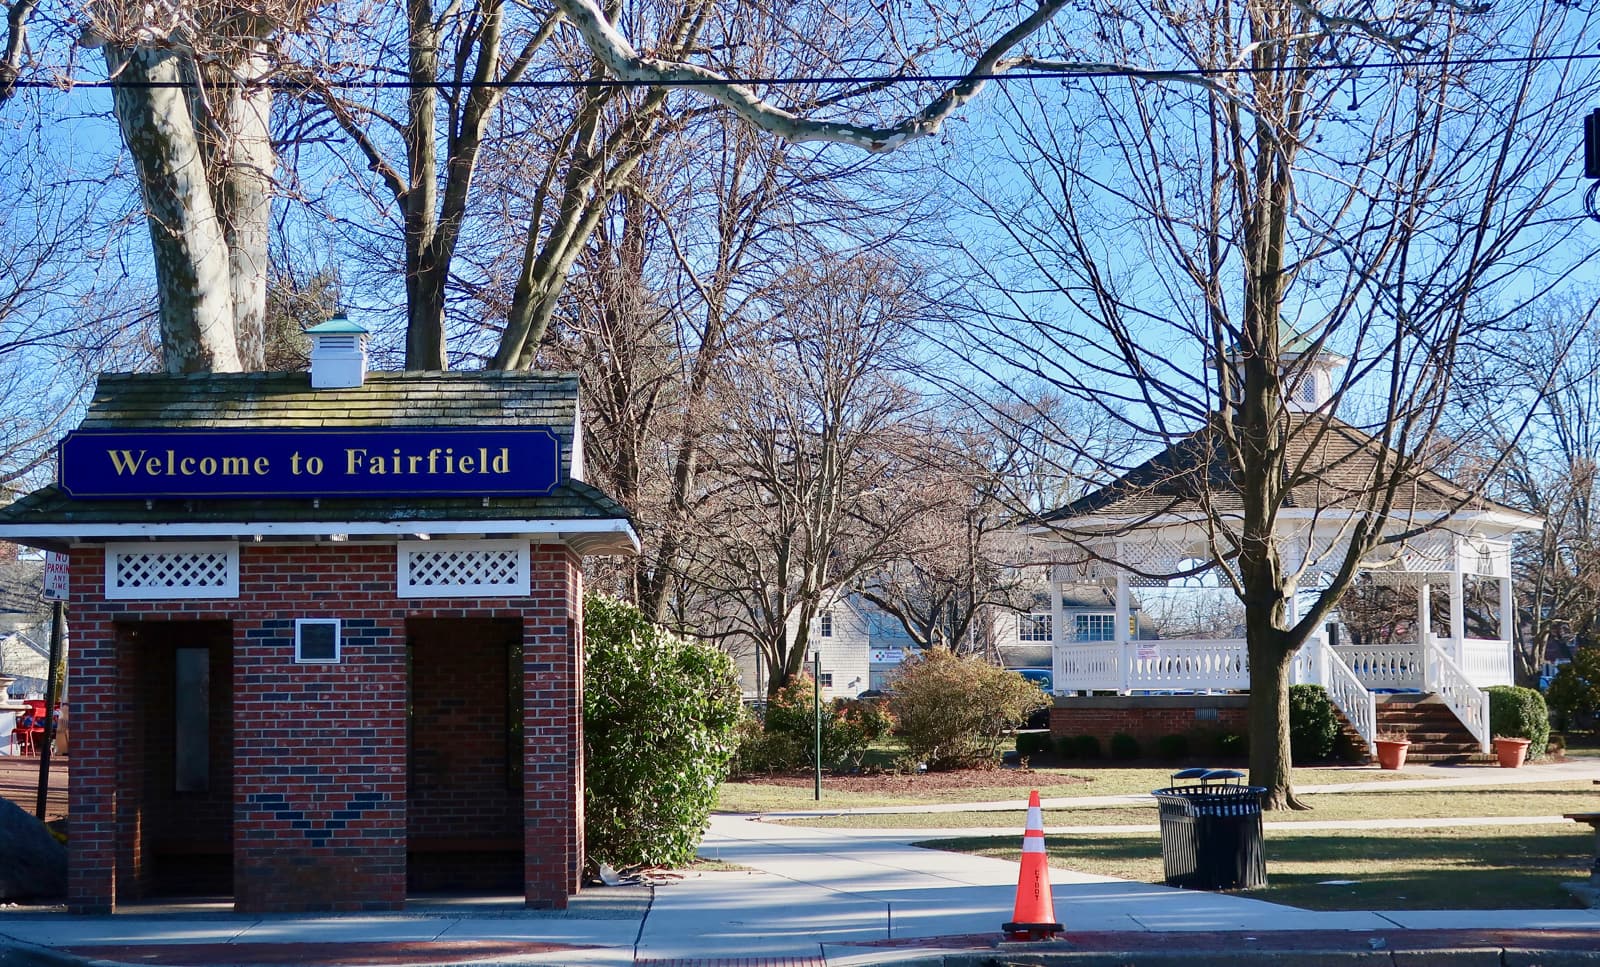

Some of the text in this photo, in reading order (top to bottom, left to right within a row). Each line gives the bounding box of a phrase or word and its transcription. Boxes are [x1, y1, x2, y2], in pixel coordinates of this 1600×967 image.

[107, 448, 511, 476] Welcome to Fairfield
[55, 552, 68, 562] NO
[47, 563, 70, 574] PARKIN
